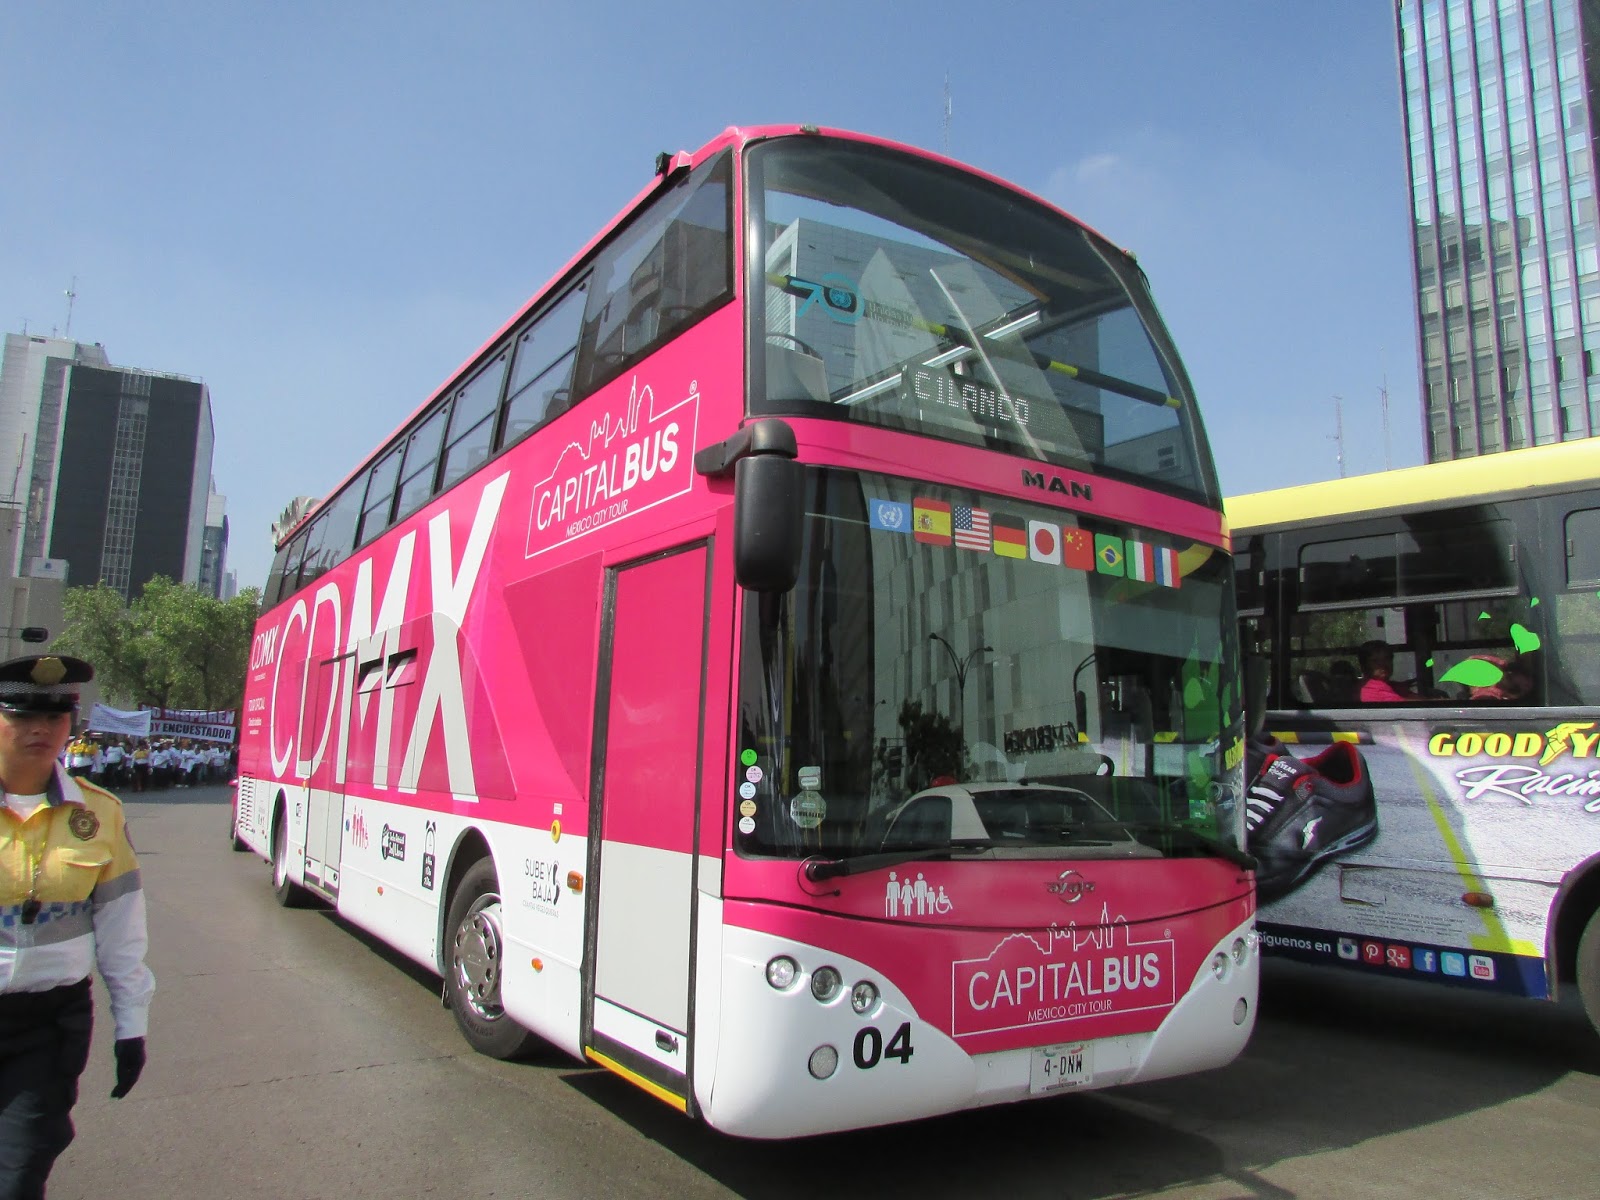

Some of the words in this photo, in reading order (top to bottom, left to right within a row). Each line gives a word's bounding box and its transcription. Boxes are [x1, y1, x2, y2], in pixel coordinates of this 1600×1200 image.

[537, 422, 680, 531] CAPITALBUS
[1020, 468, 1093, 501] MAN
[566, 512, 592, 538] MEXICO
[592, 506, 608, 527] CITY
[608, 498, 629, 520] TOUR
[251, 624, 280, 671] CDMX
[270, 470, 511, 803] CDMX
[162, 723, 232, 740] ENCUESTADOR
[1428, 732, 1600, 758] GOODY
[525, 858, 545, 880] SUBE
[546, 864, 552, 882] Y
[532, 881, 552, 906] BAJA
[1258, 931, 1312, 950] Síguenos
[1314, 942, 1331, 953] en
[1475, 957, 1487, 967] You
[968, 952, 1161, 1011] CAPITALBUS
[1027, 1005, 1067, 1022] MEXICO
[1067, 1002, 1088, 1015] CITY
[1088, 999, 1113, 1013] TOUR
[852, 1021, 915, 1070] 04
